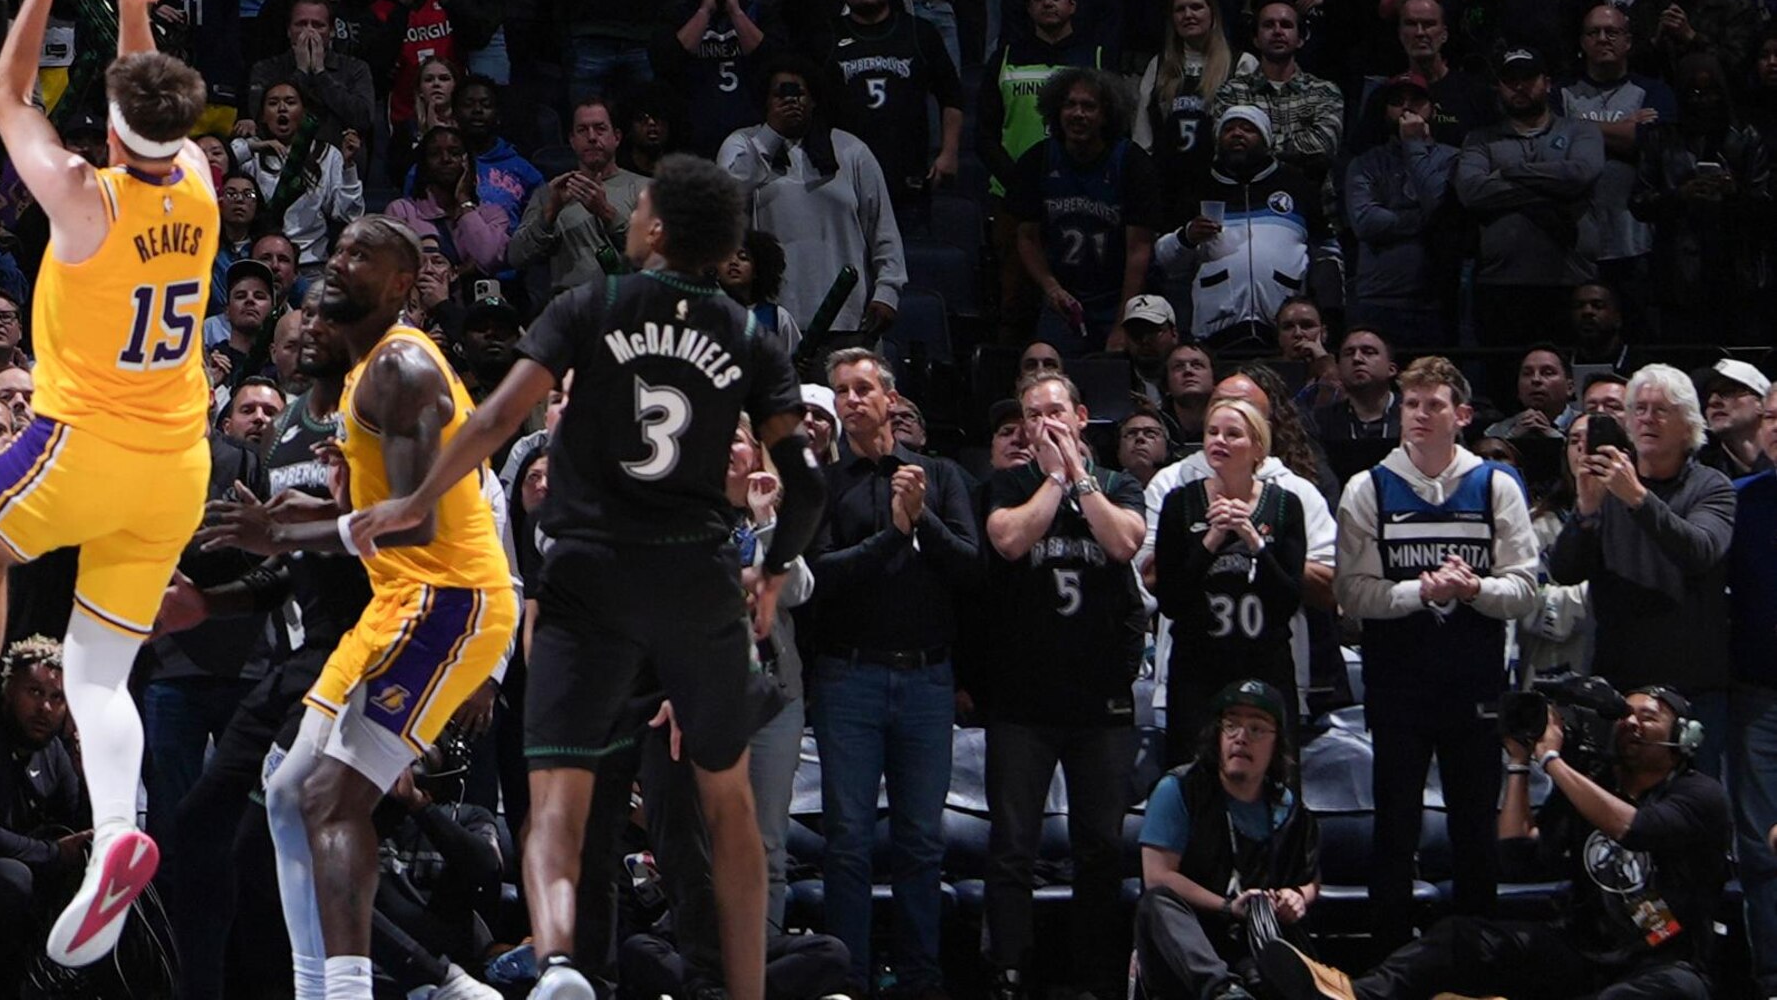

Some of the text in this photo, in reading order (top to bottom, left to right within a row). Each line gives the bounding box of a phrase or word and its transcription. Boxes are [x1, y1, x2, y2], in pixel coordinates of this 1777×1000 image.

[717, 60, 739, 93] 5
[839, 56, 913, 85] TIMBERWOLVES
[864, 77, 888, 109] 5
[1178, 119, 1200, 151] 5
[133, 222, 203, 264] REAVES
[1061, 227, 1108, 265] 21
[115, 278, 205, 372] 15
[604, 321, 745, 391] McDANIELS
[618, 373, 694, 482] 3
[1051, 566, 1084, 617] 5
[1206, 591, 1266, 641] 30
